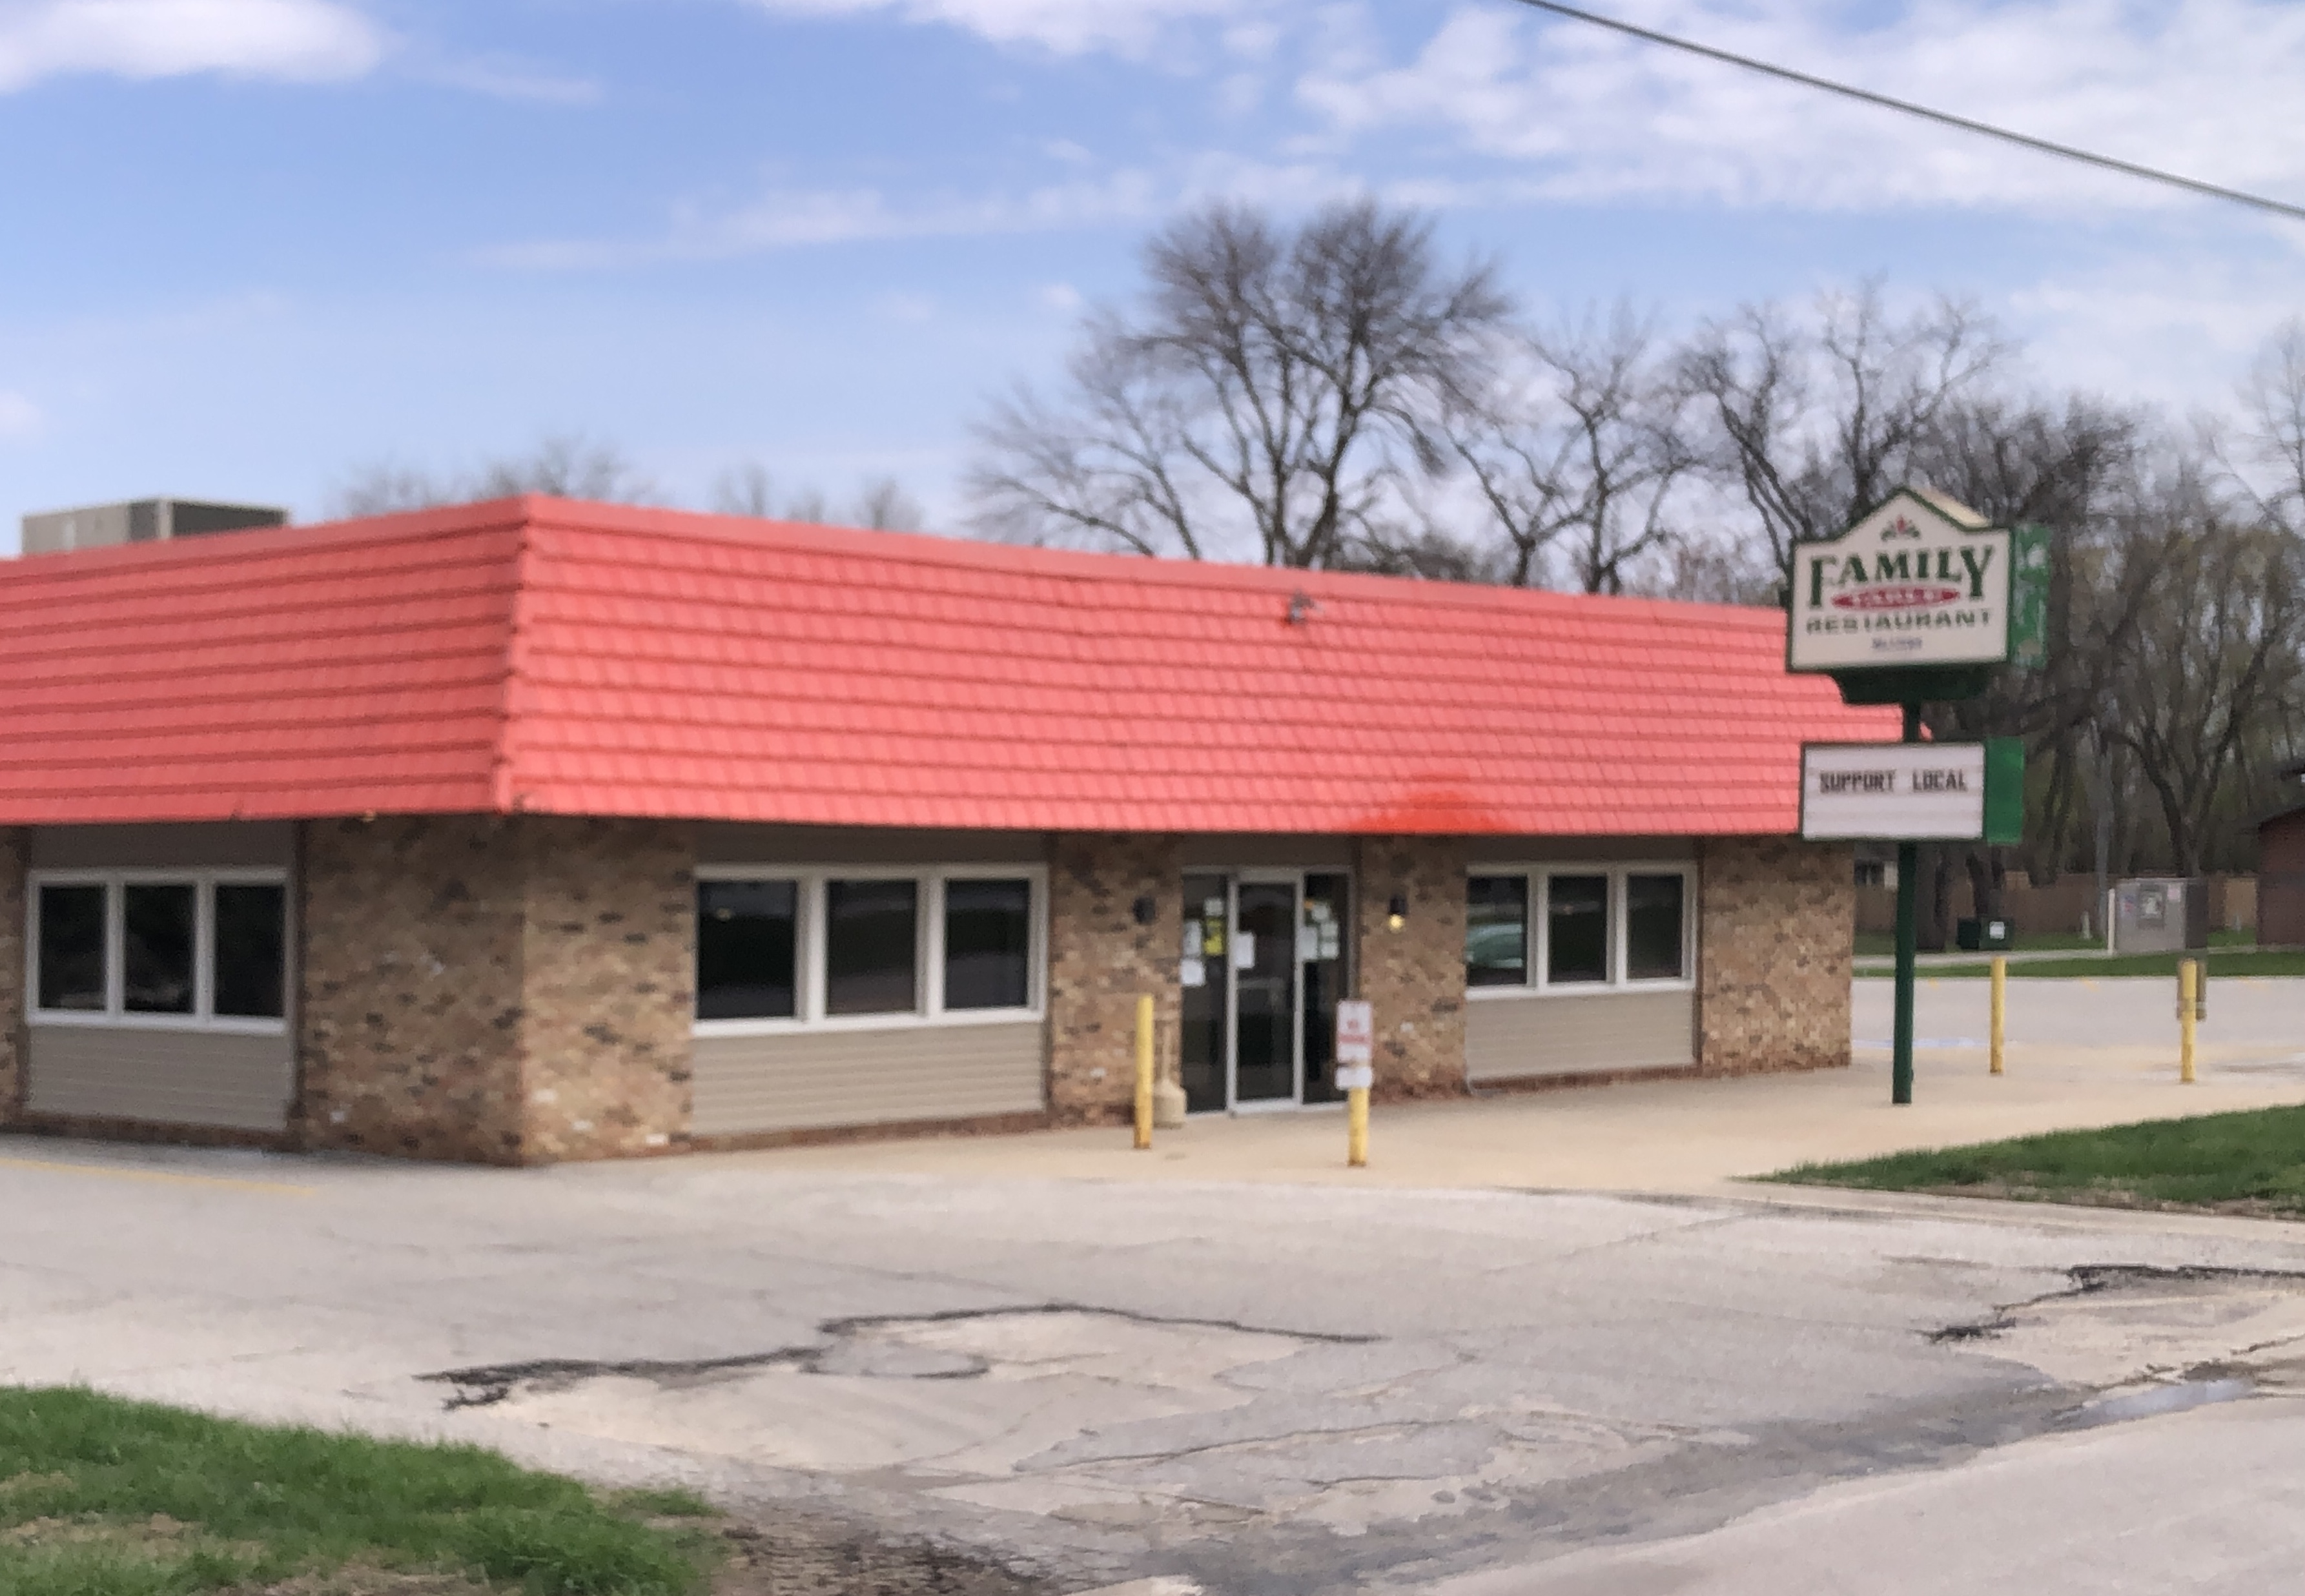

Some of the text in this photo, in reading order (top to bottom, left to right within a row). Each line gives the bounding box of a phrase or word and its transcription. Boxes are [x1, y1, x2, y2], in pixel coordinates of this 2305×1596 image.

[1809, 544, 1994, 609] FAMILY
[1806, 609, 1990, 635] RESTAURANT
[1819, 769, 1968, 793] SUPPORT LOCAL
